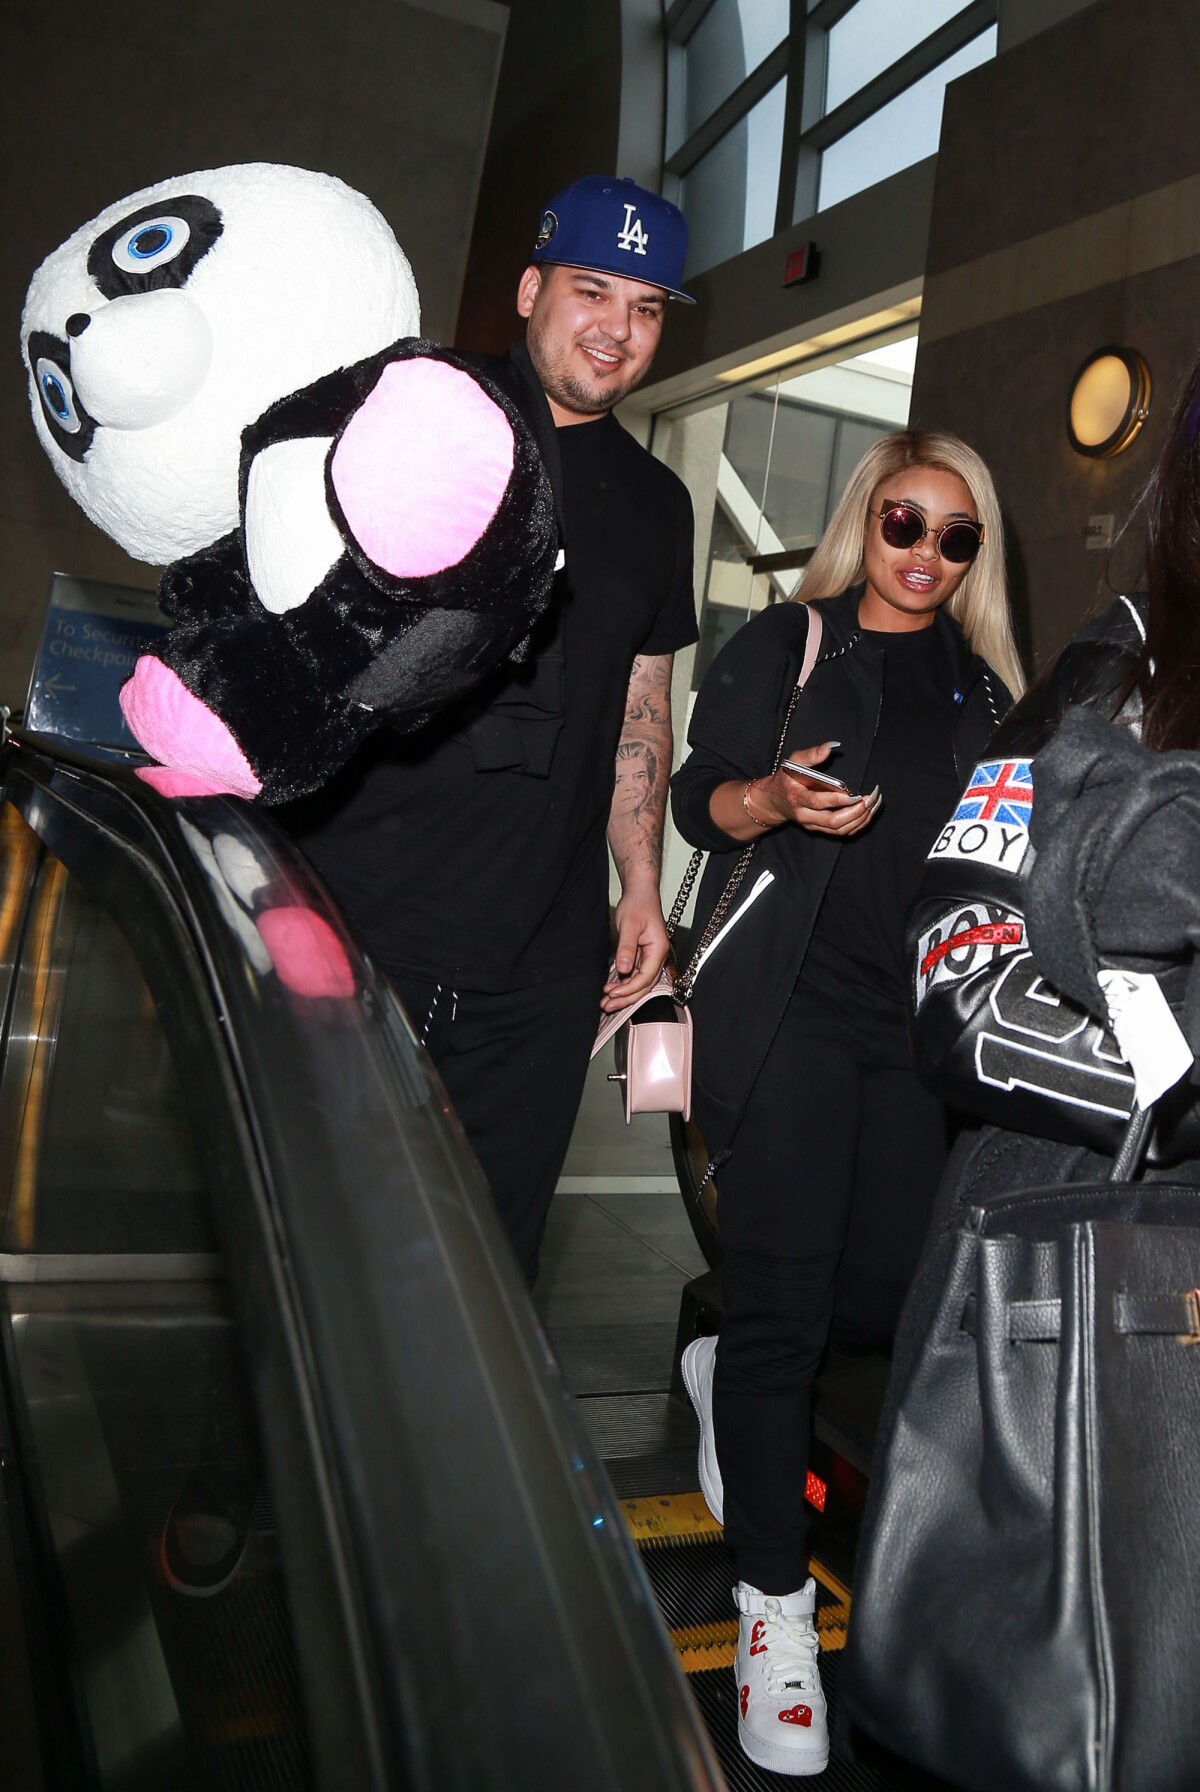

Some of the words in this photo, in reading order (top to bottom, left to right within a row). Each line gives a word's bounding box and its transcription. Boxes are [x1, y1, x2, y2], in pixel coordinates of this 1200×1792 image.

[617, 203, 649, 256] LA
[55, 620, 76, 637] To
[933, 824, 1024, 862] BOY
